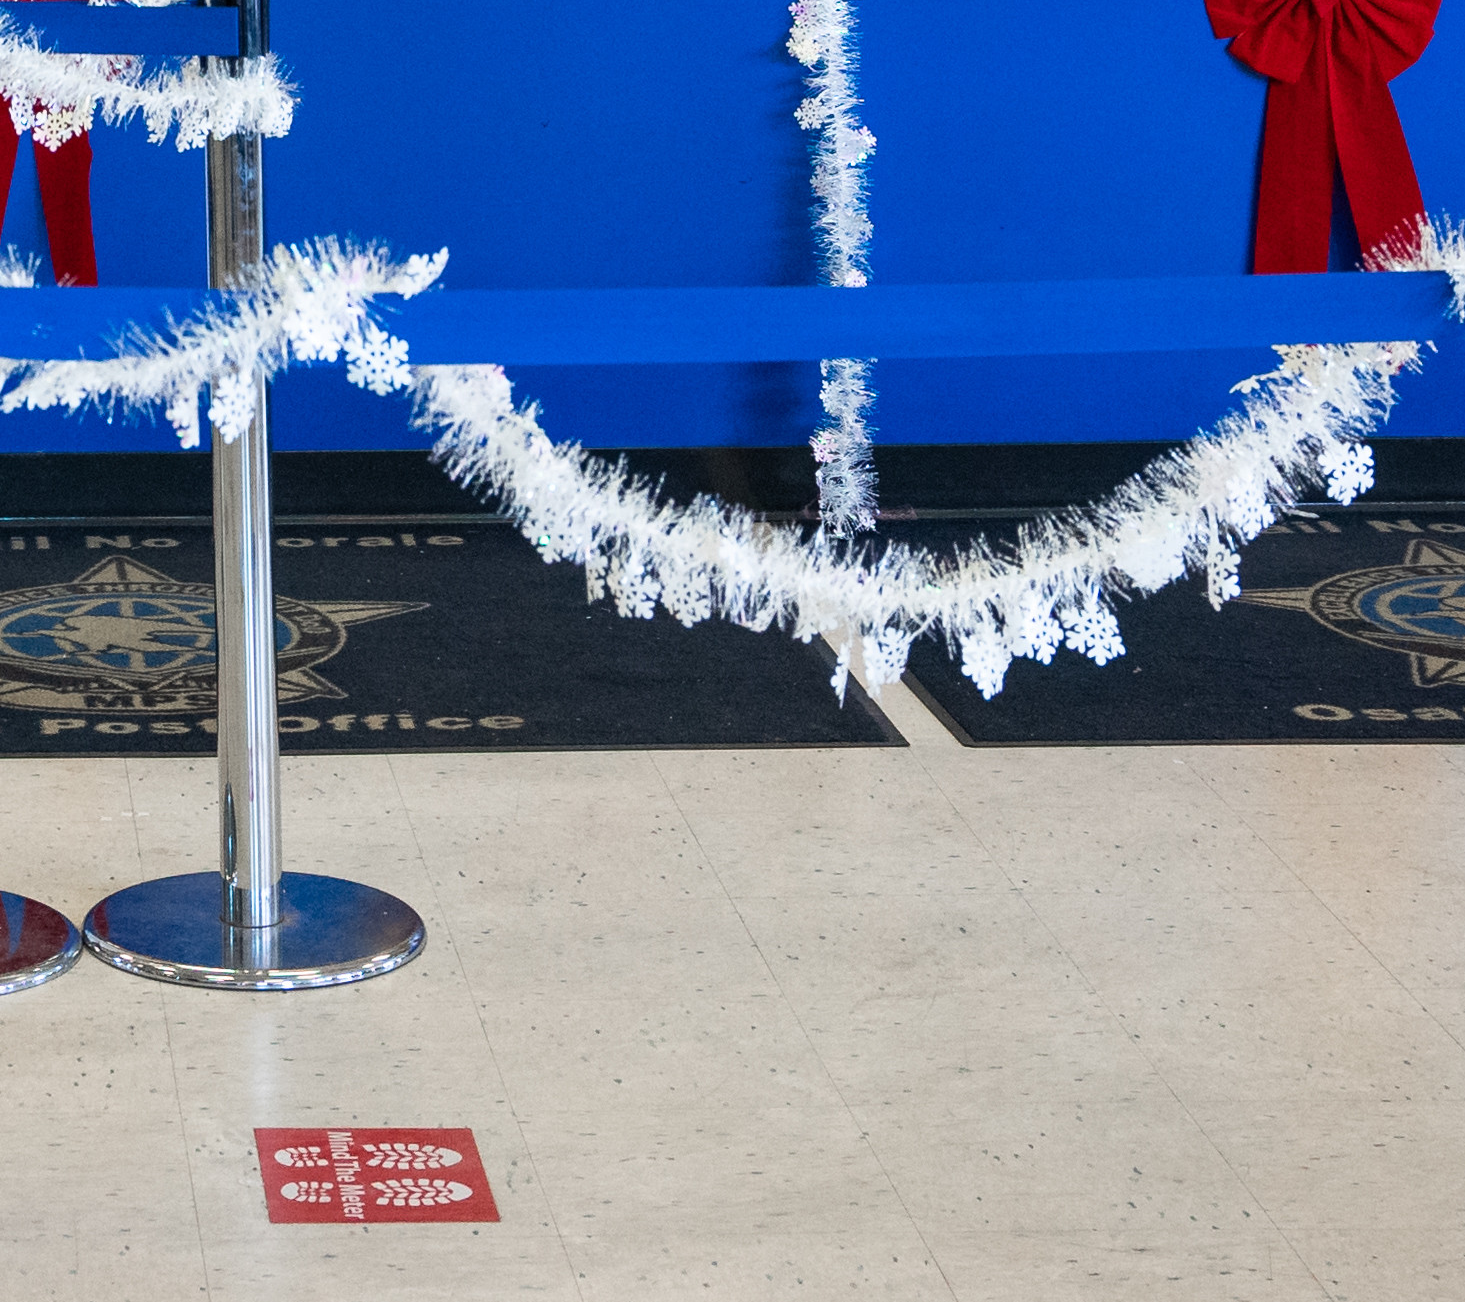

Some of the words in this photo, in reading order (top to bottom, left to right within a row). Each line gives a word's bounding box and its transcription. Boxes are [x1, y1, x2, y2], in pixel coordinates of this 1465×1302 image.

[1263, 521, 1342, 533] ail
[85, 536, 181, 549] No
[277, 533, 465, 548] orale
[278, 714, 525, 732] Office
[327, 1131, 358, 1159] Mind
[334, 1161, 361, 1182] The
[339, 1185, 366, 1219] Meter
